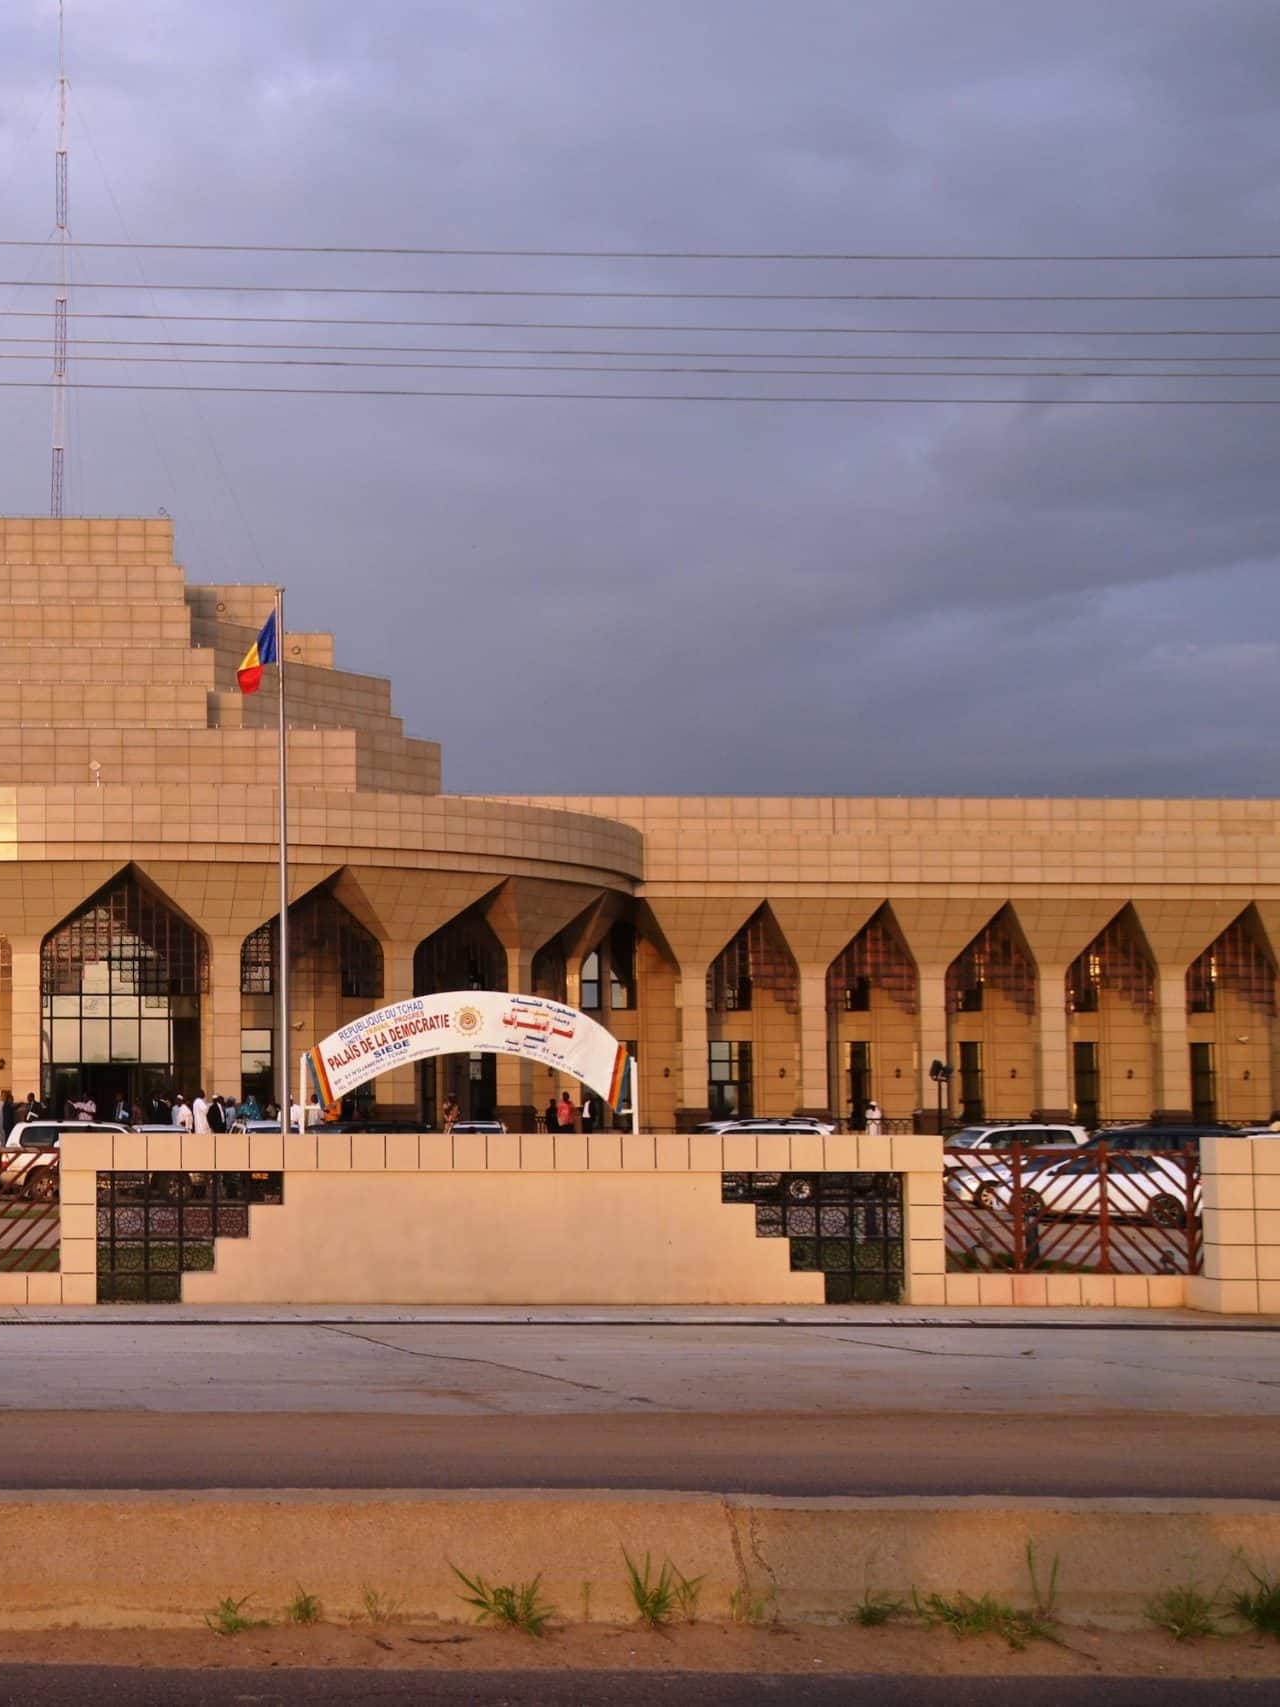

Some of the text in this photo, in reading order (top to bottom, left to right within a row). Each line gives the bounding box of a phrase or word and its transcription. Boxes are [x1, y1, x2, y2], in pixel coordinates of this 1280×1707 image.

[338, 1000, 424, 1041] REPUBLIQUE DU TCHAD
[327, 1013, 450, 1072] PALAIS DE LA DEMOCRATIE
[373, 1039, 411, 1059] SIEGE
